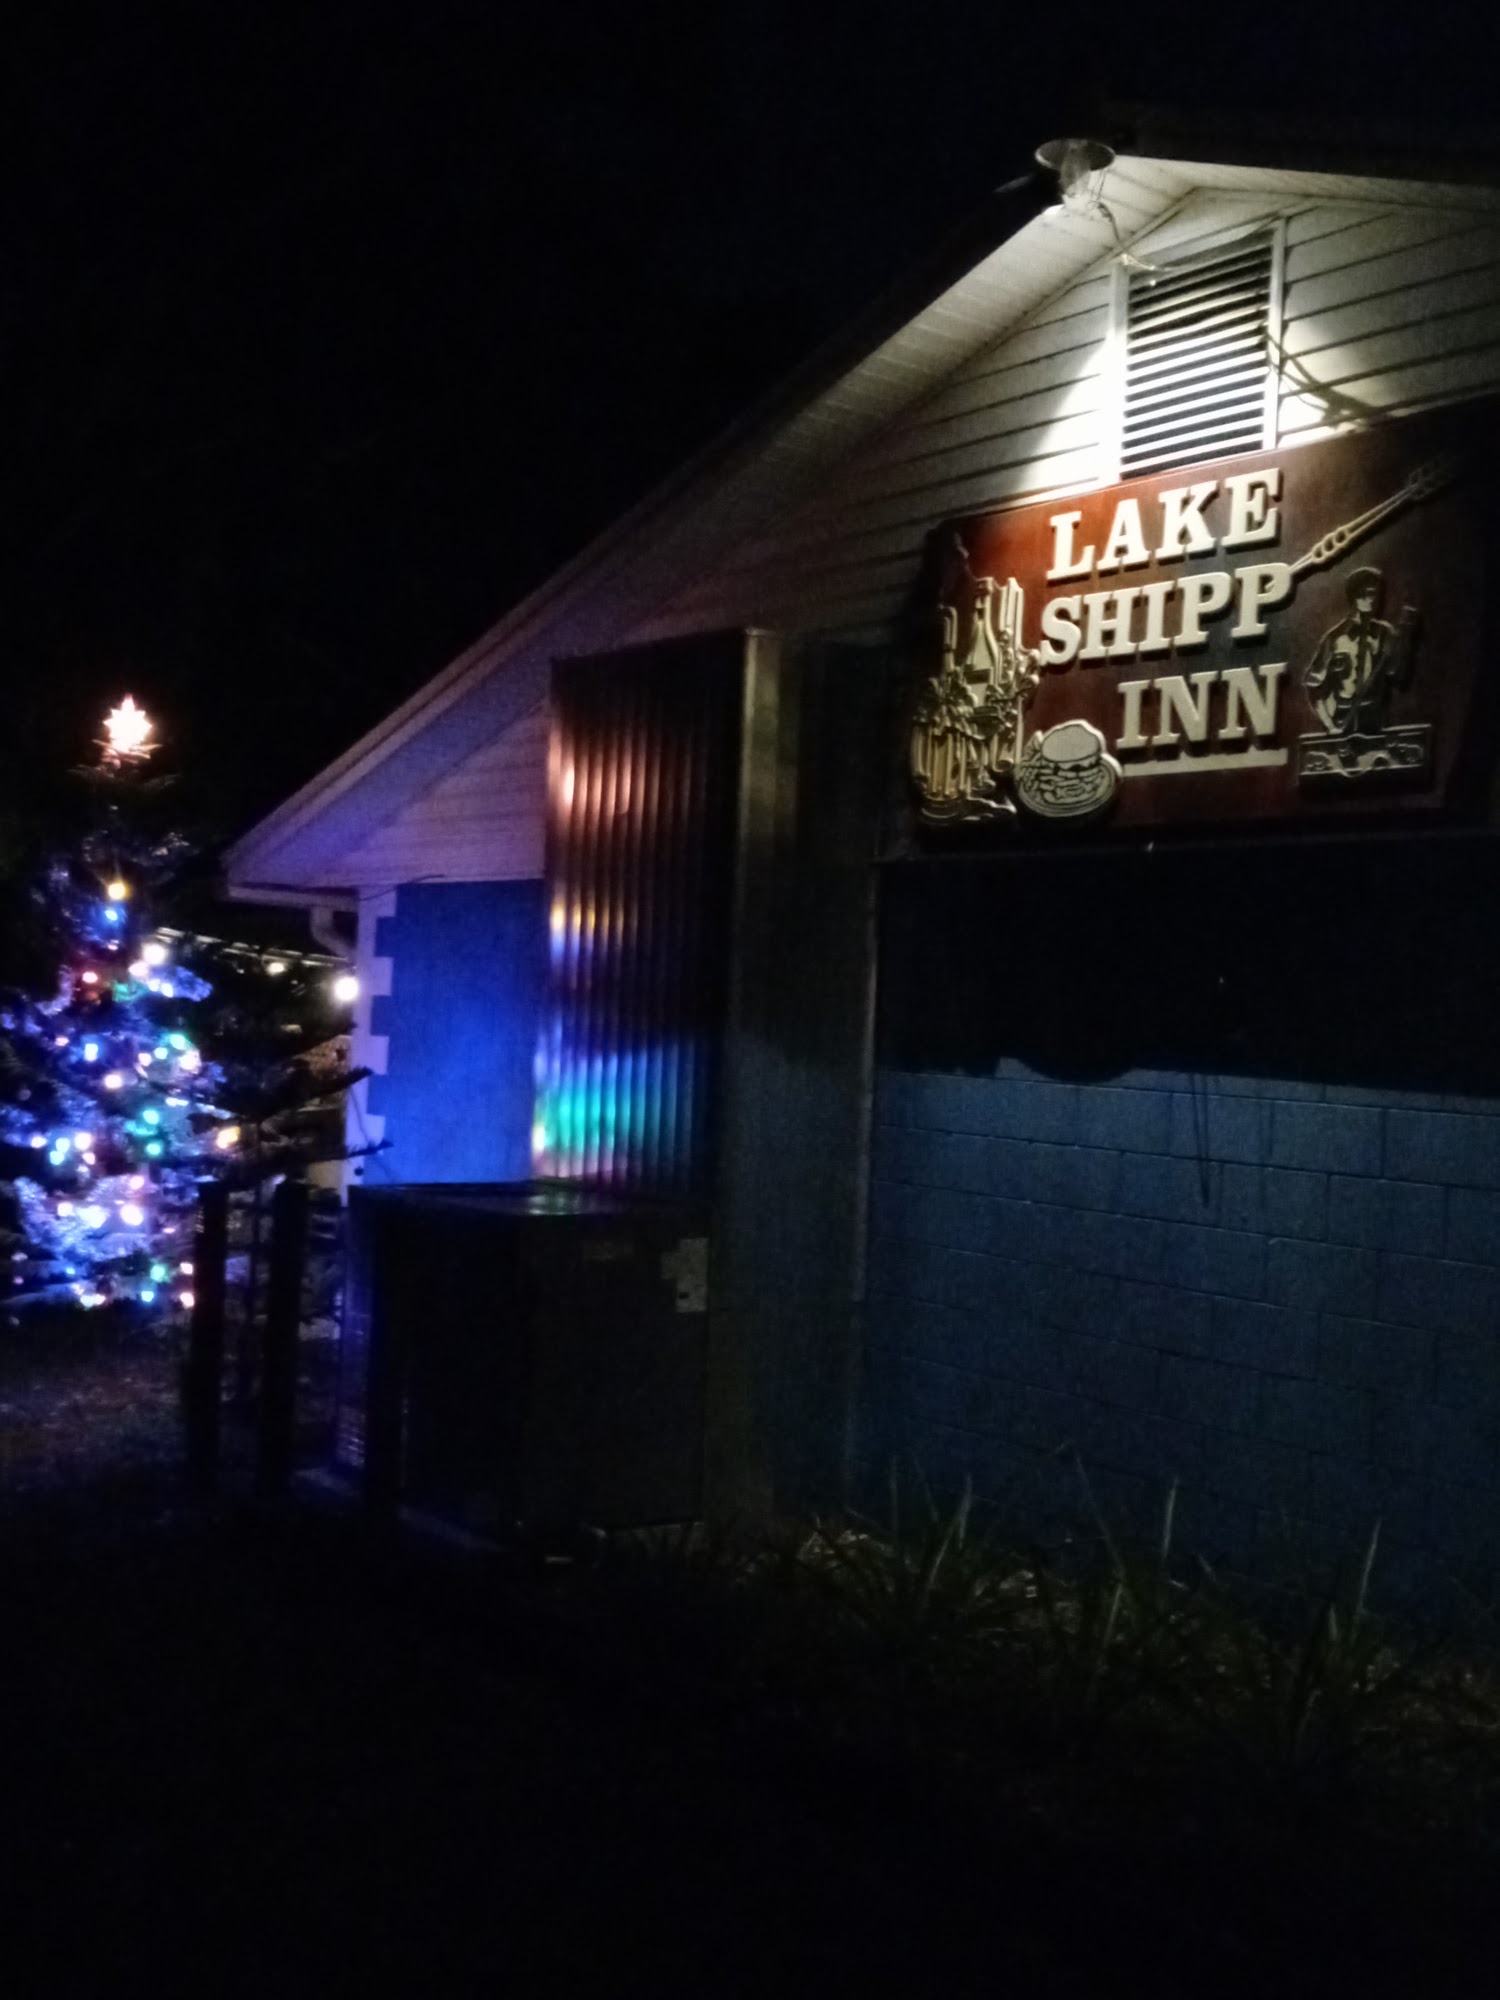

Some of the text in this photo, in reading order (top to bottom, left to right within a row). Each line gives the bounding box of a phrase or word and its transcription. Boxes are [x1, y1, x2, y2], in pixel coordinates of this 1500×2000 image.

[1046, 468, 1280, 580] LAKE
[1039, 562, 1292, 666] SHIPP
[1116, 662, 1288, 749] INN
